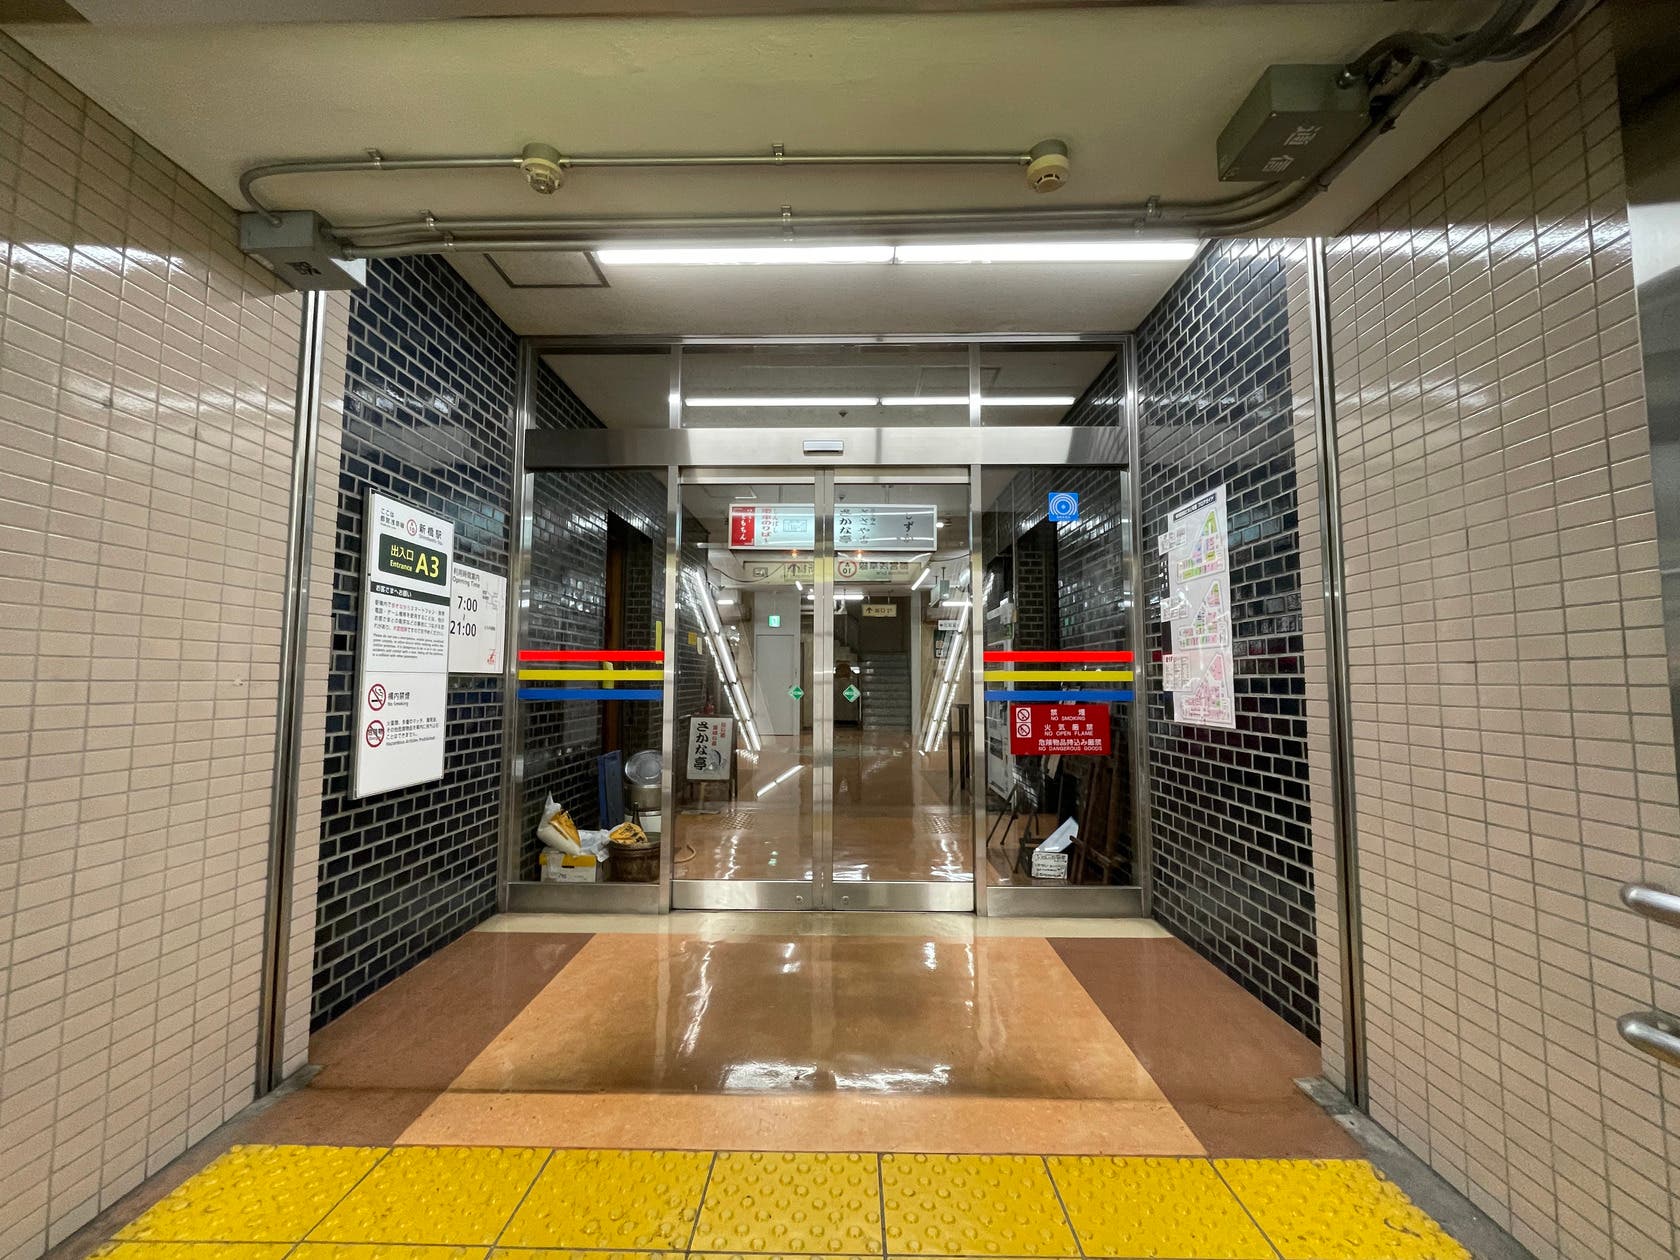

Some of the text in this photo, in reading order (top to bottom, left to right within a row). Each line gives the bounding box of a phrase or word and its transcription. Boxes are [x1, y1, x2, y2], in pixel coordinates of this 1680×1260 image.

[419, 523, 442, 540] 新橋駅
[390, 544, 414, 560] 出入口
[389, 552, 440, 578] Entrance A3
[452, 576, 480, 589] Opening Time
[457, 595, 478, 612] 7:00
[450, 620, 477, 637] 21:00
[388, 691, 410, 701] 構内禁煙
[1044, 723, 1094, 731] 火気厳禁
[693, 720, 709, 771] さかな亭
[1038, 738, 1102, 746] 危険物品持込み厳禁
